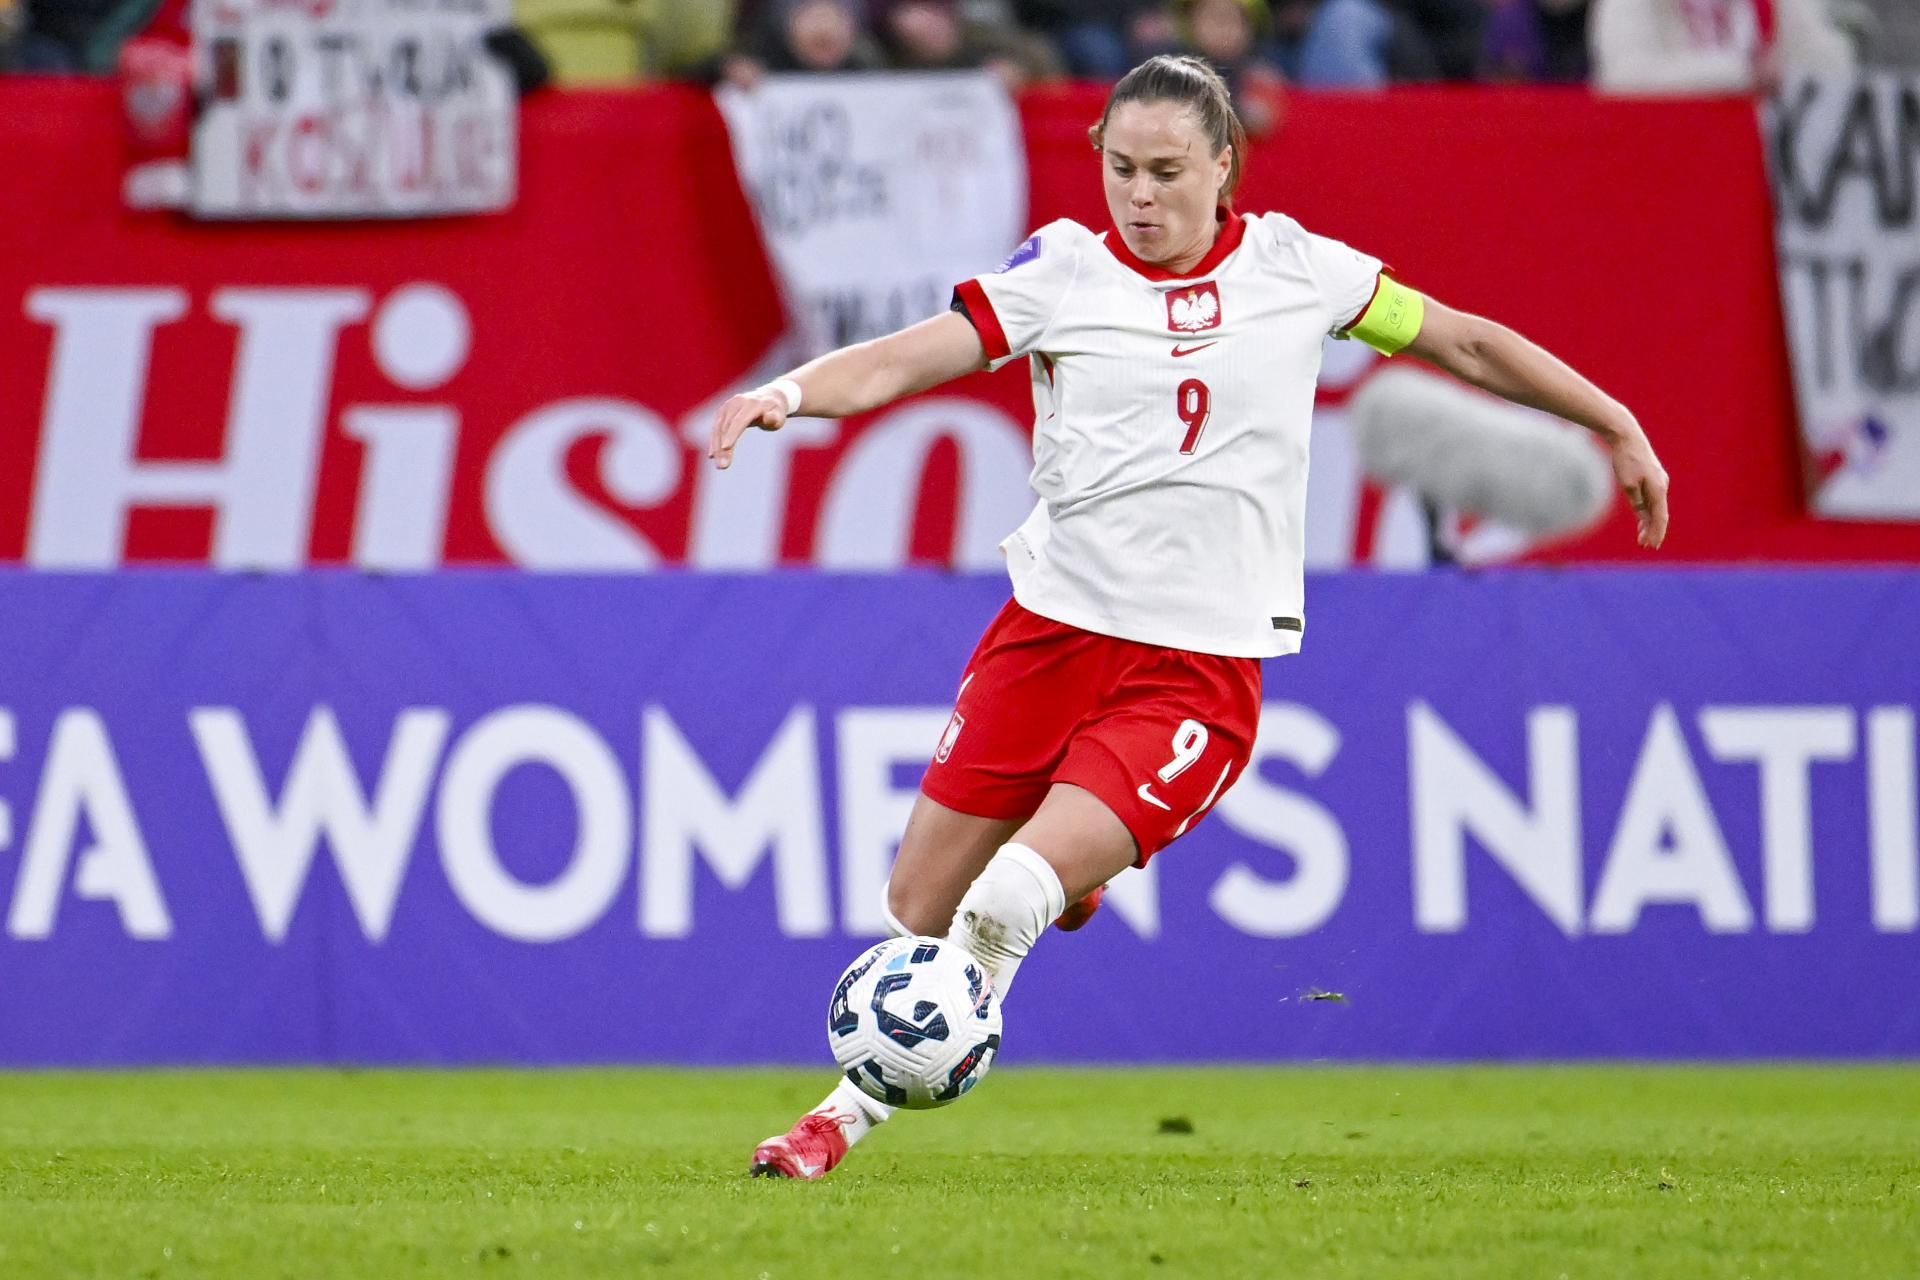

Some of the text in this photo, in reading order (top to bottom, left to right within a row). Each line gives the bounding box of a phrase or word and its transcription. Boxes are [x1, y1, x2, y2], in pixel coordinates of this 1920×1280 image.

[1177, 378, 1211, 455] 9
[1157, 718, 1208, 784] 9
[0, 698, 1918, 943] A WOMES NATI
